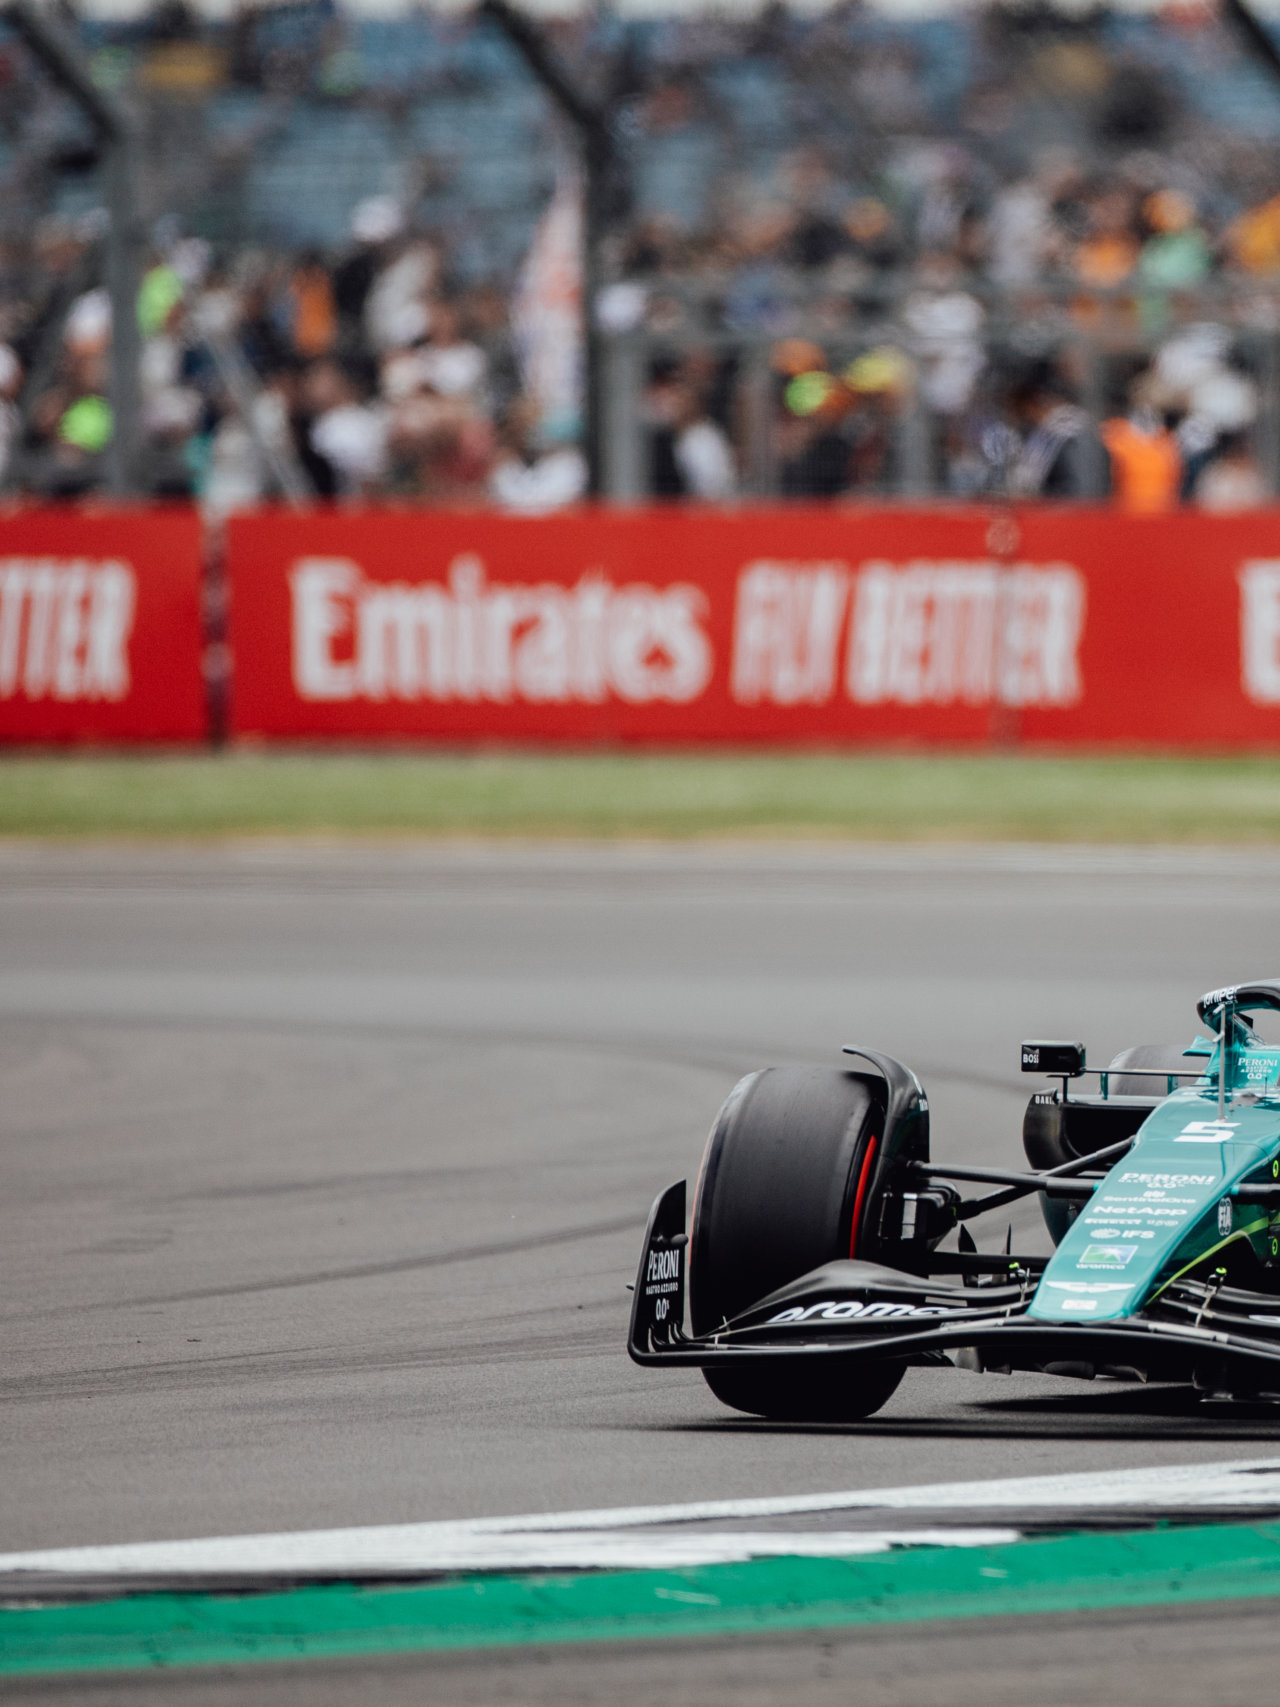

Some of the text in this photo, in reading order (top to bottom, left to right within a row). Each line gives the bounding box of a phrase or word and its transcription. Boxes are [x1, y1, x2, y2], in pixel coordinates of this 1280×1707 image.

[291, 554, 1086, 706] Emirates FLY BETTER
[1238, 1058, 1278, 1067] PERONI
[1173, 1121, 1241, 1143] 5
[1121, 1173, 1216, 1184] PERONI
[1093, 1206, 1187, 1216] NetApp
[1122, 1230, 1155, 1239] IFS
[647, 1250, 679, 1281] PERONI
